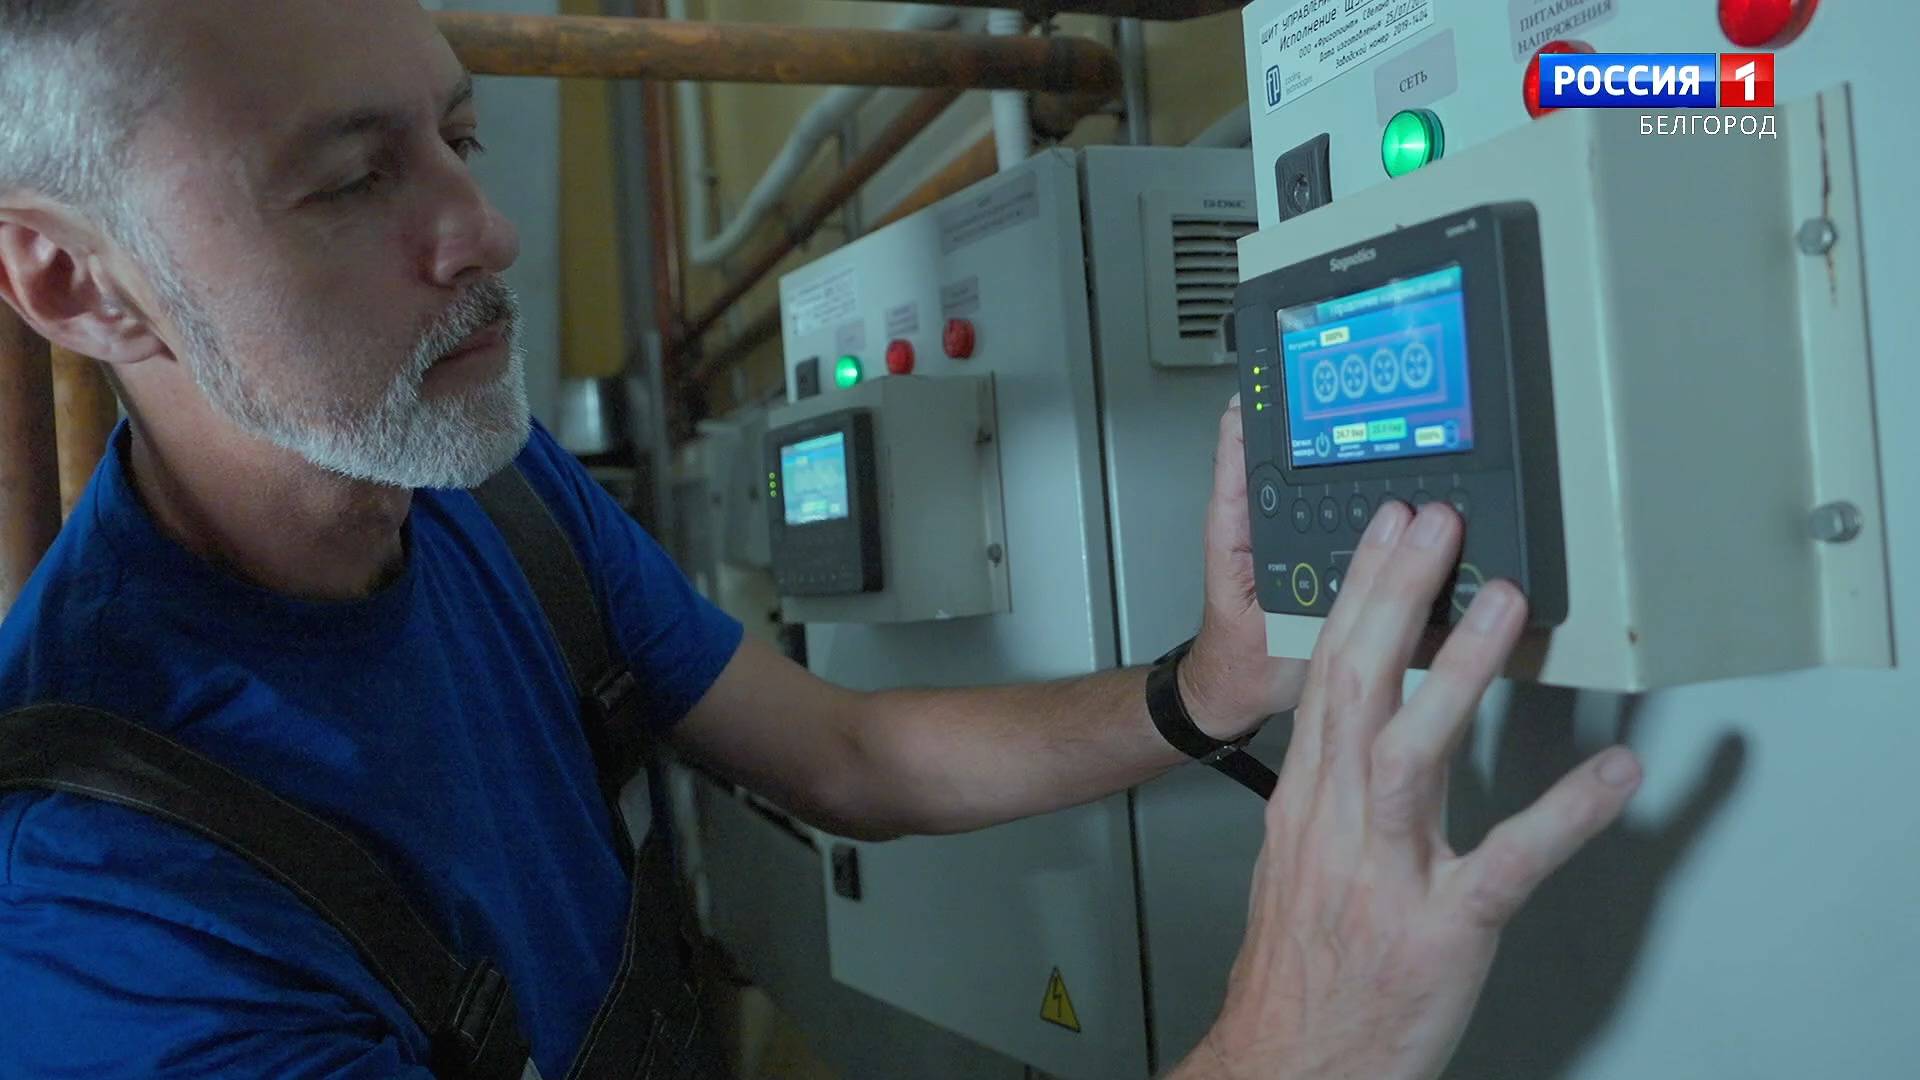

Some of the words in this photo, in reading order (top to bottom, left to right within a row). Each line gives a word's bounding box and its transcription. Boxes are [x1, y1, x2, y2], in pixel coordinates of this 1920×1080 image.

[1280, 8, 1337, 52] Исполнение
[1518, 0, 1611, 54] НАПРЯЖЕНИЯ
[1399, 71, 1428, 93] СЕТЬ
